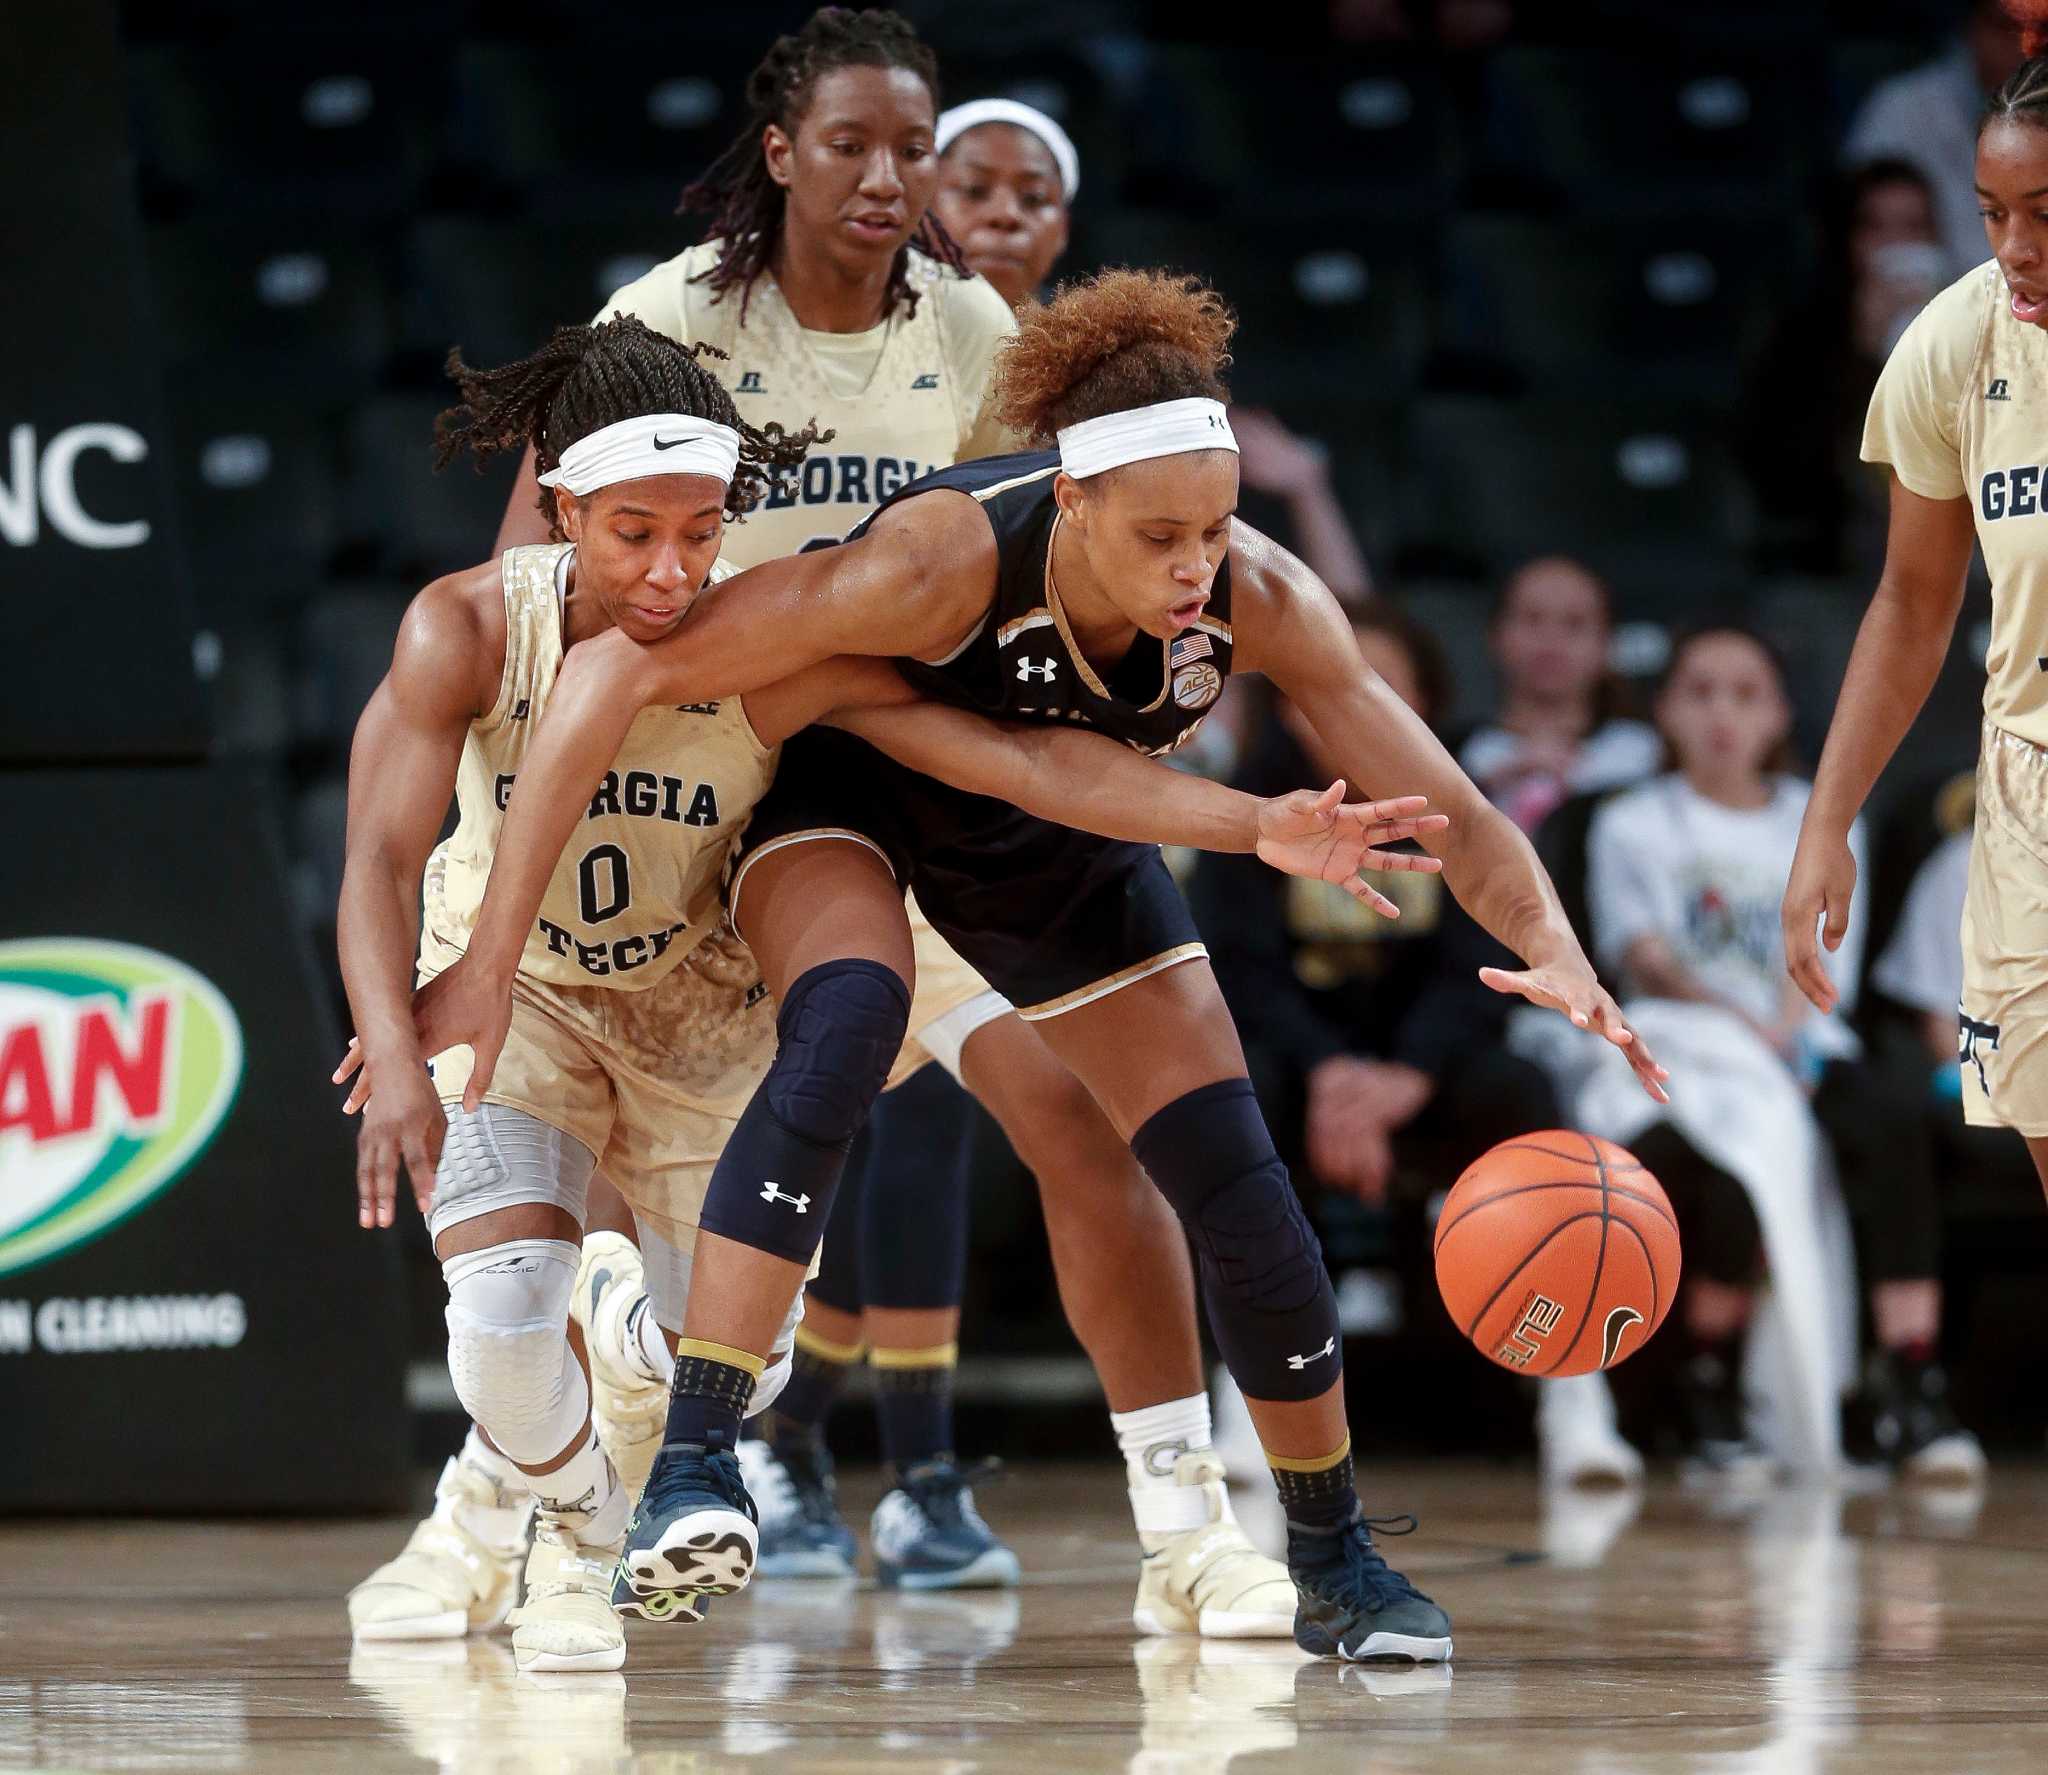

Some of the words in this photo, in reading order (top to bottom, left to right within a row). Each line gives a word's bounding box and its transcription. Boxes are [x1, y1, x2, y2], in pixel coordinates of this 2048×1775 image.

[1982, 466, 2048, 521] GE
[1179, 671, 1216, 699] ACC
[495, 770, 719, 826] GRGIA
[579, 843, 631, 925] 0
[35, 1294, 247, 1353] CLEANING
[1499, 1295, 1565, 1368] ELITE
